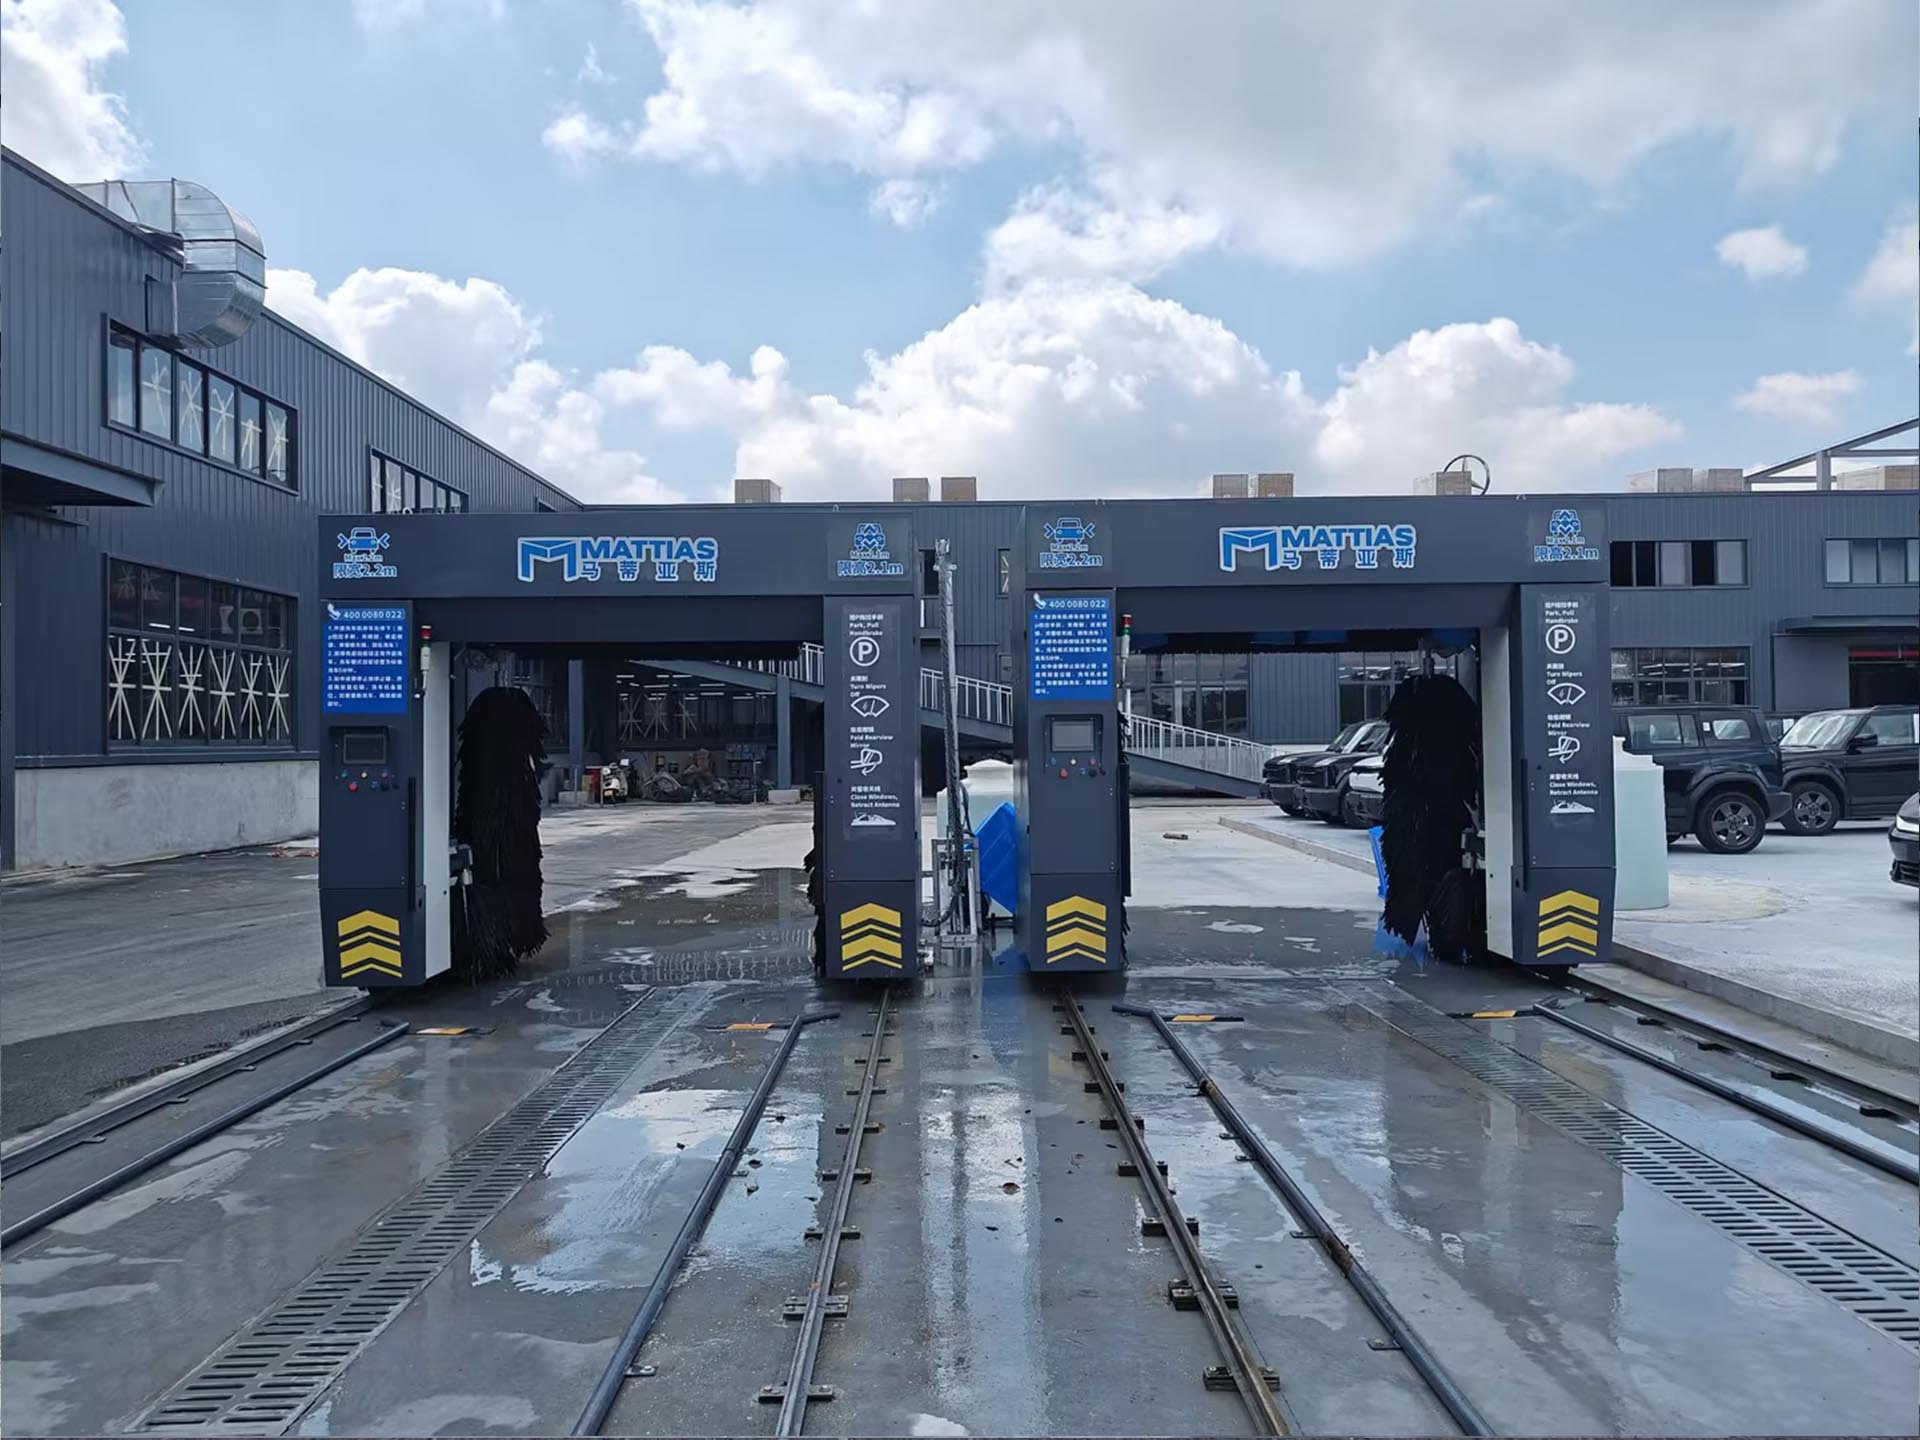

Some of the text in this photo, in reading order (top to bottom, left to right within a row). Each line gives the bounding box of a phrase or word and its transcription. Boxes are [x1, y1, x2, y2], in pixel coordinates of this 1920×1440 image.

[1281, 525, 1416, 549] MATTIAS
[580, 537, 718, 560] MATTIAS
[1281, 549, 1416, 569] 马蒂亚斯
[580, 560, 717, 581] 马蒂亚斯
[1049, 600, 1106, 608] 400 0080 022
[343, 610, 402, 619] 400 0080 022
